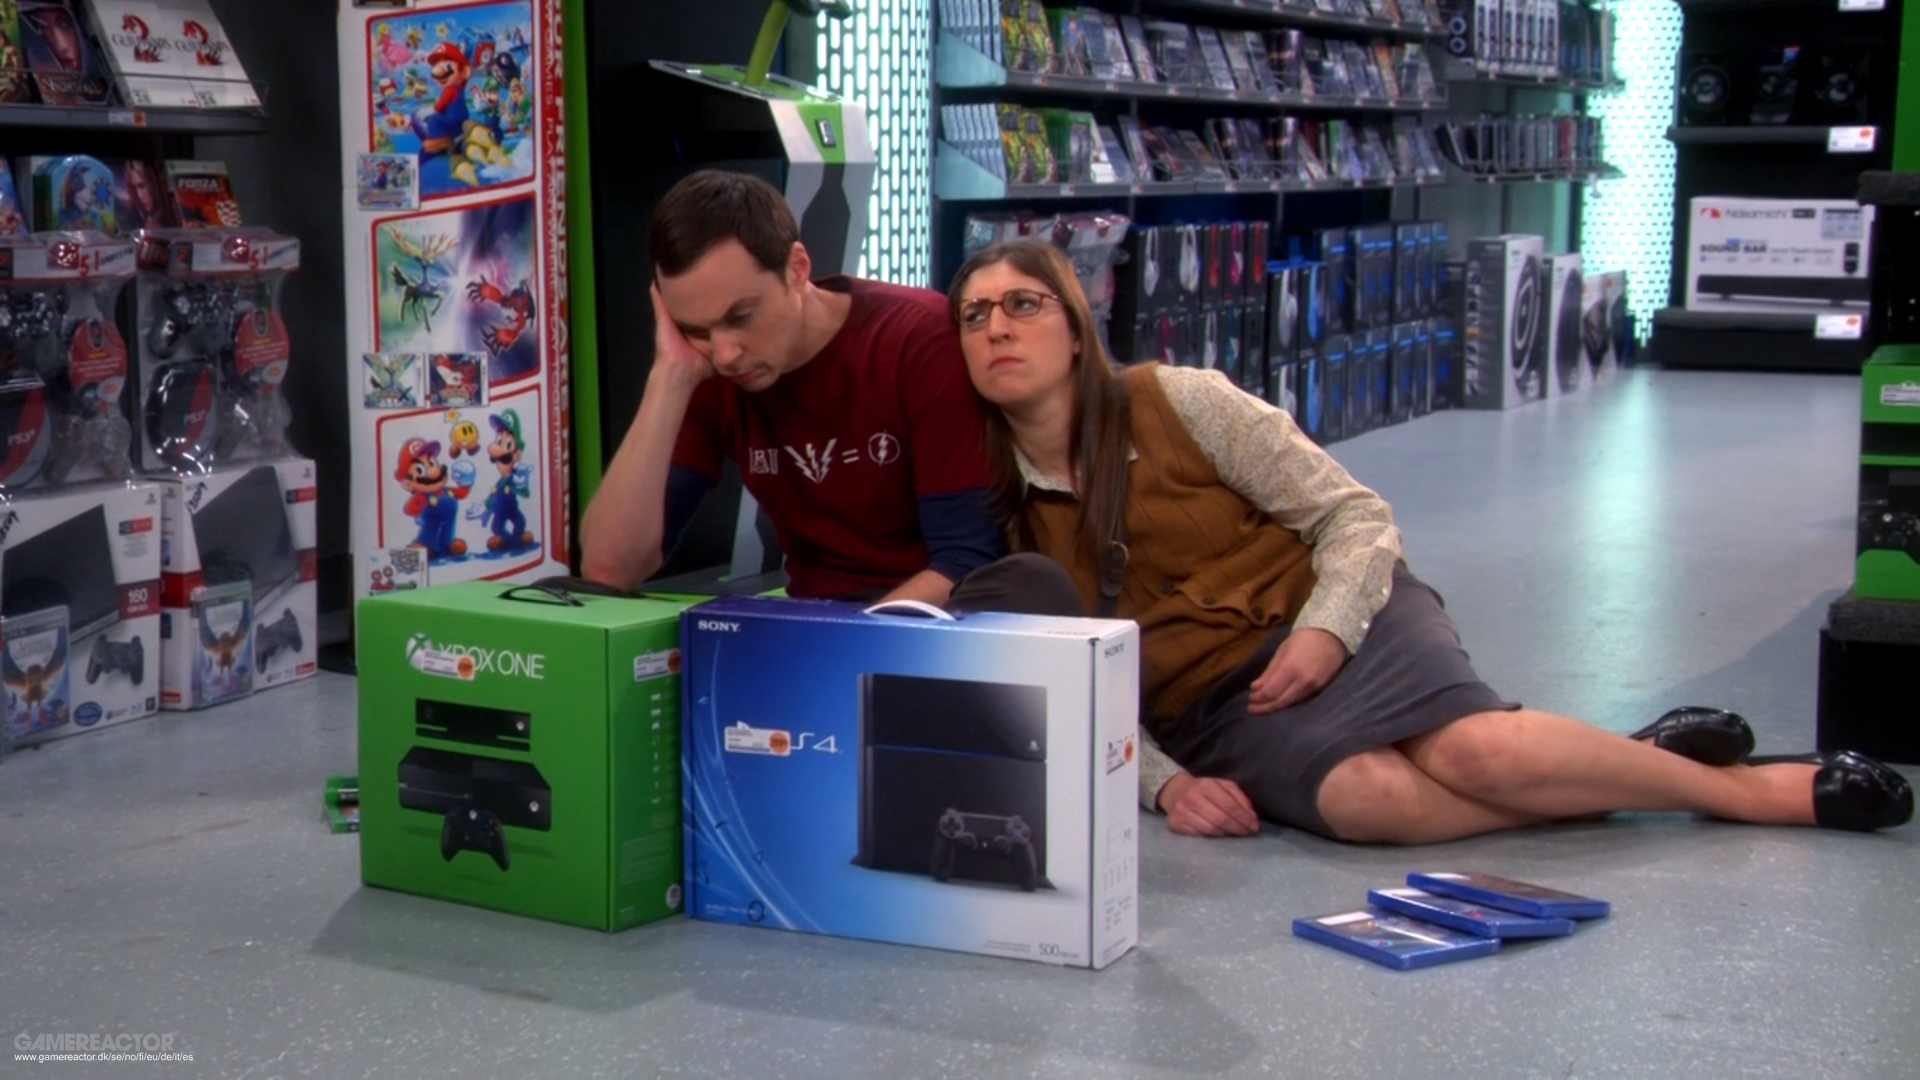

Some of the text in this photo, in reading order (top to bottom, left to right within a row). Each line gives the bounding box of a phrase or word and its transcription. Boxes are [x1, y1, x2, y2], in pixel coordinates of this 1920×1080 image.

[546, 117, 556, 167] PLAY
[555, 95, 567, 300] FRIENDS
[1743, 244, 1767, 253] BAR
[560, 317, 569, 412] ARE
[127, 587, 149, 604] 160
[698, 620, 740, 632] SONY
[497, 650, 545, 679] ONE
[790, 731, 838, 754] S4
[1038, 942, 1060, 957] 500
